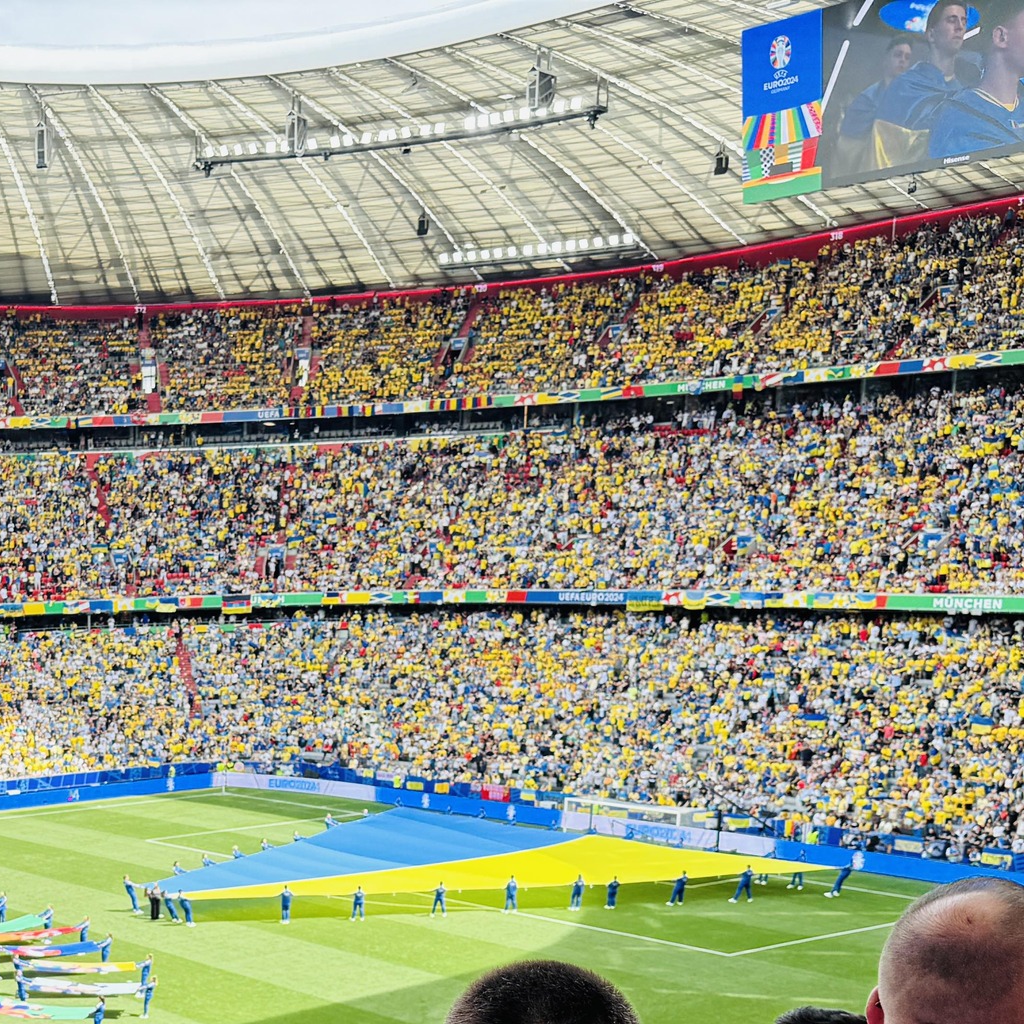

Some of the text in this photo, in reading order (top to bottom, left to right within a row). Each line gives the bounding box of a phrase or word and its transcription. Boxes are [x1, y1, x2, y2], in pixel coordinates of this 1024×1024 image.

[763, 75, 799, 91] EURO2024
[943, 155, 970, 165] Hisense
[933, 596, 1003, 609] MÜNCHEN
